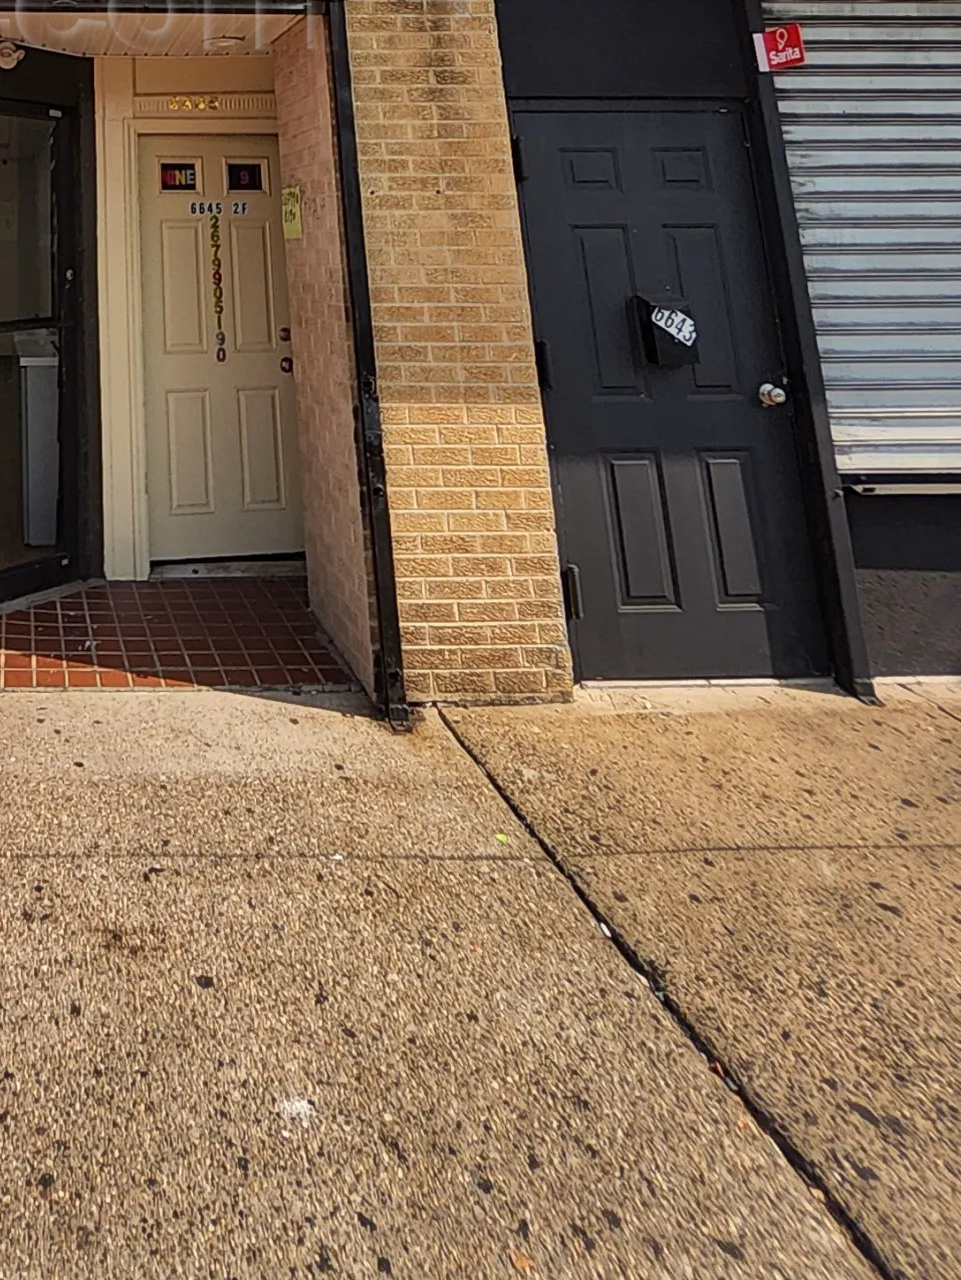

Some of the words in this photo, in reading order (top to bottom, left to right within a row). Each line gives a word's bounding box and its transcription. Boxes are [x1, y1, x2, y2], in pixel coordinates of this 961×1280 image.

[769, 46, 802, 65] Sarita
[190, 202, 222, 214] 6645
[233, 202, 248, 214] 2F
[653, 305, 696, 343] 6643
